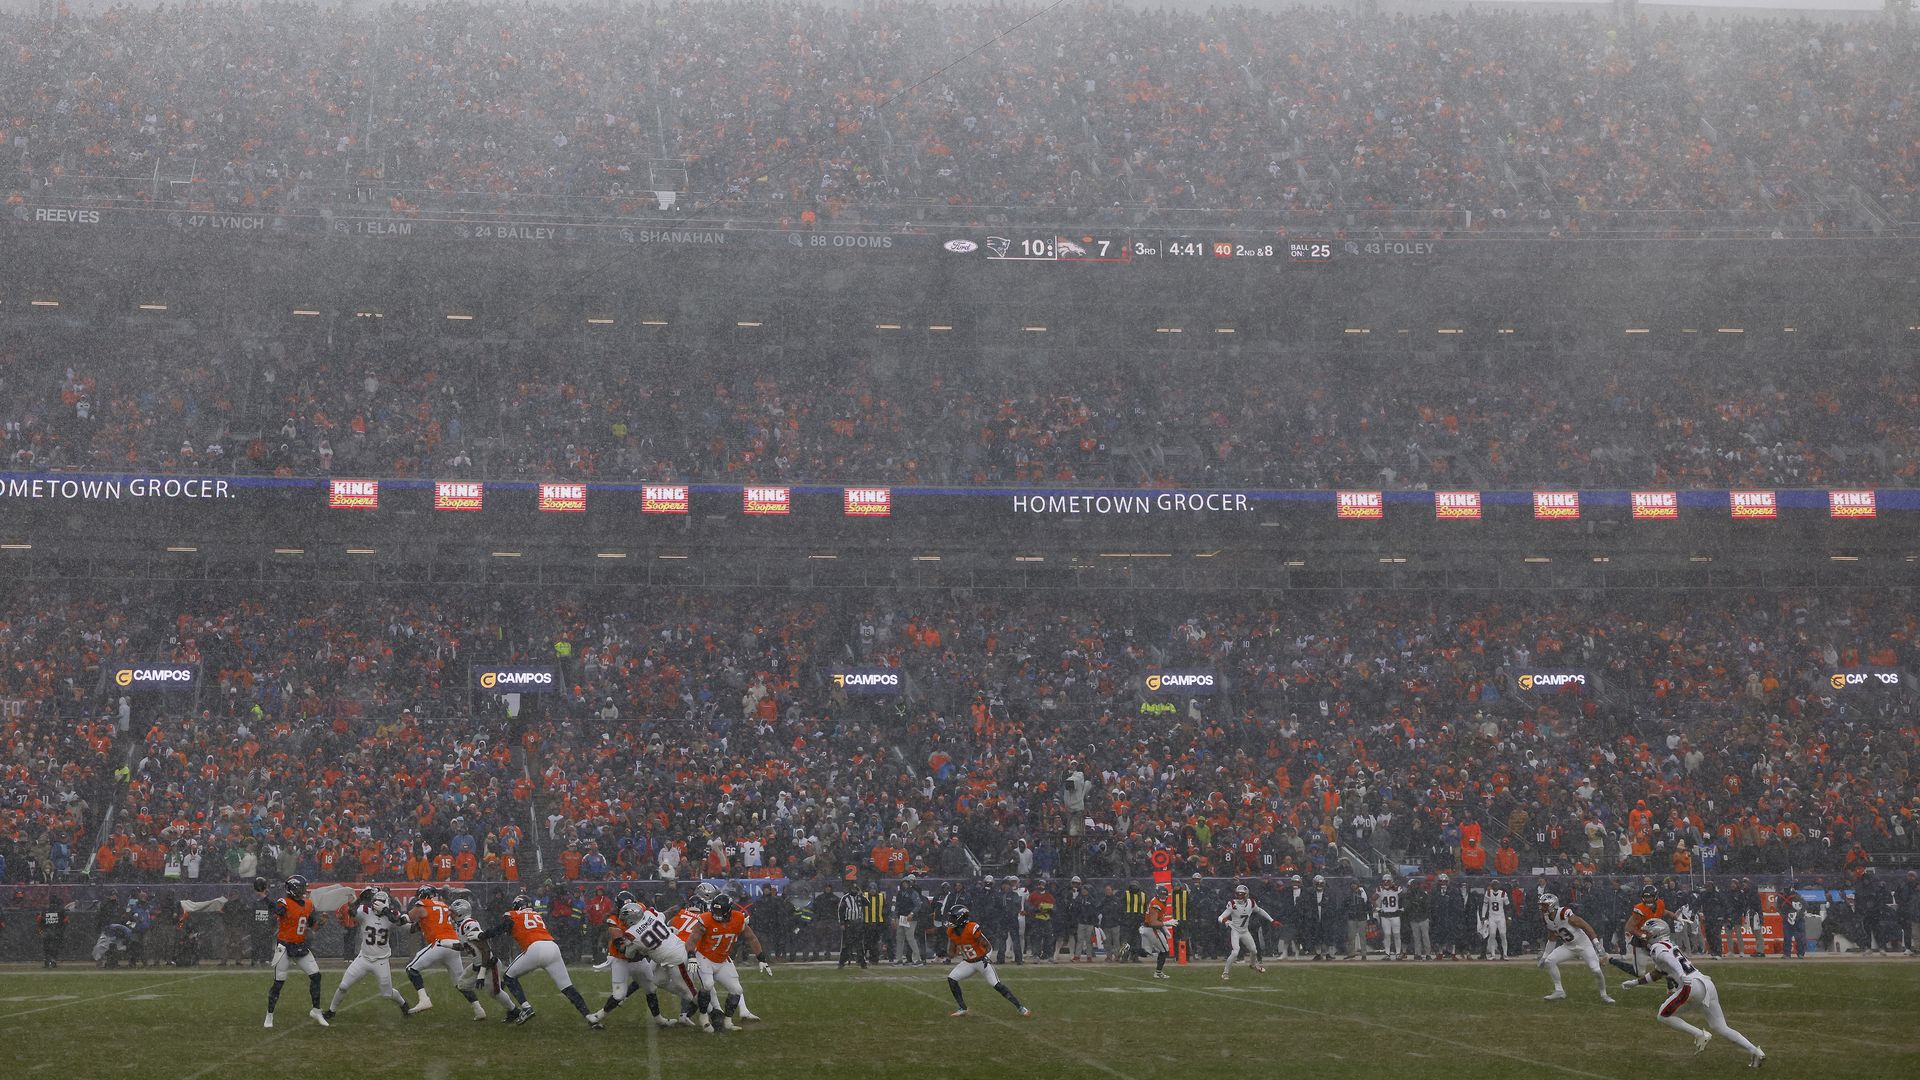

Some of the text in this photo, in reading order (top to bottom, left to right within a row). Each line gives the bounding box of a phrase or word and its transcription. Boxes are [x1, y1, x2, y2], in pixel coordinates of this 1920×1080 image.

[36, 208, 100, 223] REEVES
[189, 216, 264, 230] 47 LYNCH
[356, 222, 412, 235] 1 ELAM
[475, 226, 555, 240] 24 BAILEY
[640, 230, 724, 244] SHANAHAN
[810, 235, 892, 248] 88 ODOMS
[1021, 240, 1045, 256] 10
[1098, 240, 1110, 257] 7
[1169, 242, 1203, 256] 4:41
[1215, 244, 1231, 256] 40
[1311, 245, 1330, 257] 25
[1364, 243, 1434, 254] 43 FOLEY
[129, 478, 235, 499] GROCER.
[334, 482, 374, 495] KING
[440, 484, 479, 497] KING
[543, 486, 582, 499] KING
[646, 487, 684, 500] KING
[333, 494, 374, 507] Soopers
[747, 489, 786, 502] KING
[849, 490, 887, 503] KING
[1341, 493, 1378, 506] KING
[1439, 493, 1477, 506] KING
[1538, 493, 1575, 506] KING
[1635, 493, 1673, 506] KING
[1734, 493, 1772, 506] KING
[1833, 493, 1870, 505] KING
[439, 496, 479, 509] Soopers
[543, 497, 582, 510] Soopers
[645, 499, 685, 512] Soopers
[747, 500, 787, 513] Soopers
[848, 502, 887, 515] Soopers
[1013, 493, 1254, 513] HOMETOWN GROCER.
[1340, 505, 1379, 518] Soopers
[1439, 505, 1478, 518] Soopers
[1538, 505, 1576, 518] Soopers
[1636, 505, 1674, 518] Soopers
[1735, 504, 1773, 517] Soopers
[1833, 504, 1872, 517] Soopers
[134, 670, 191, 681] CAMPOS
[497, 673, 552, 684] CAMPOS
[845, 674, 898, 685] CAMPOS
[1161, 675, 1214, 686] CAMPOS
[1533, 674, 1586, 685] CAMPOS
[1846, 673, 1899, 684] CAOS
[1536, 833, 1545, 842] 10
[1783, 828, 1792, 837] 18
[749, 847, 755, 856] 2
[1245, 843, 1254, 852] 10
[325, 855, 333, 864] 18
[892, 852, 903, 861] 58
[1225, 853, 1231, 861] 8
[1263, 855, 1272, 864] 10
[441, 859, 451, 868] 15
[845, 865, 857, 880] 2
[1382, 896, 1398, 908] 48
[1491, 902, 1499, 912] 8
[297, 917, 306, 935] 8
[1240, 914, 1249, 928] 7
[365, 926, 388, 946] 33
[640, 920, 670, 950] 90
[711, 933, 736, 951] 77
